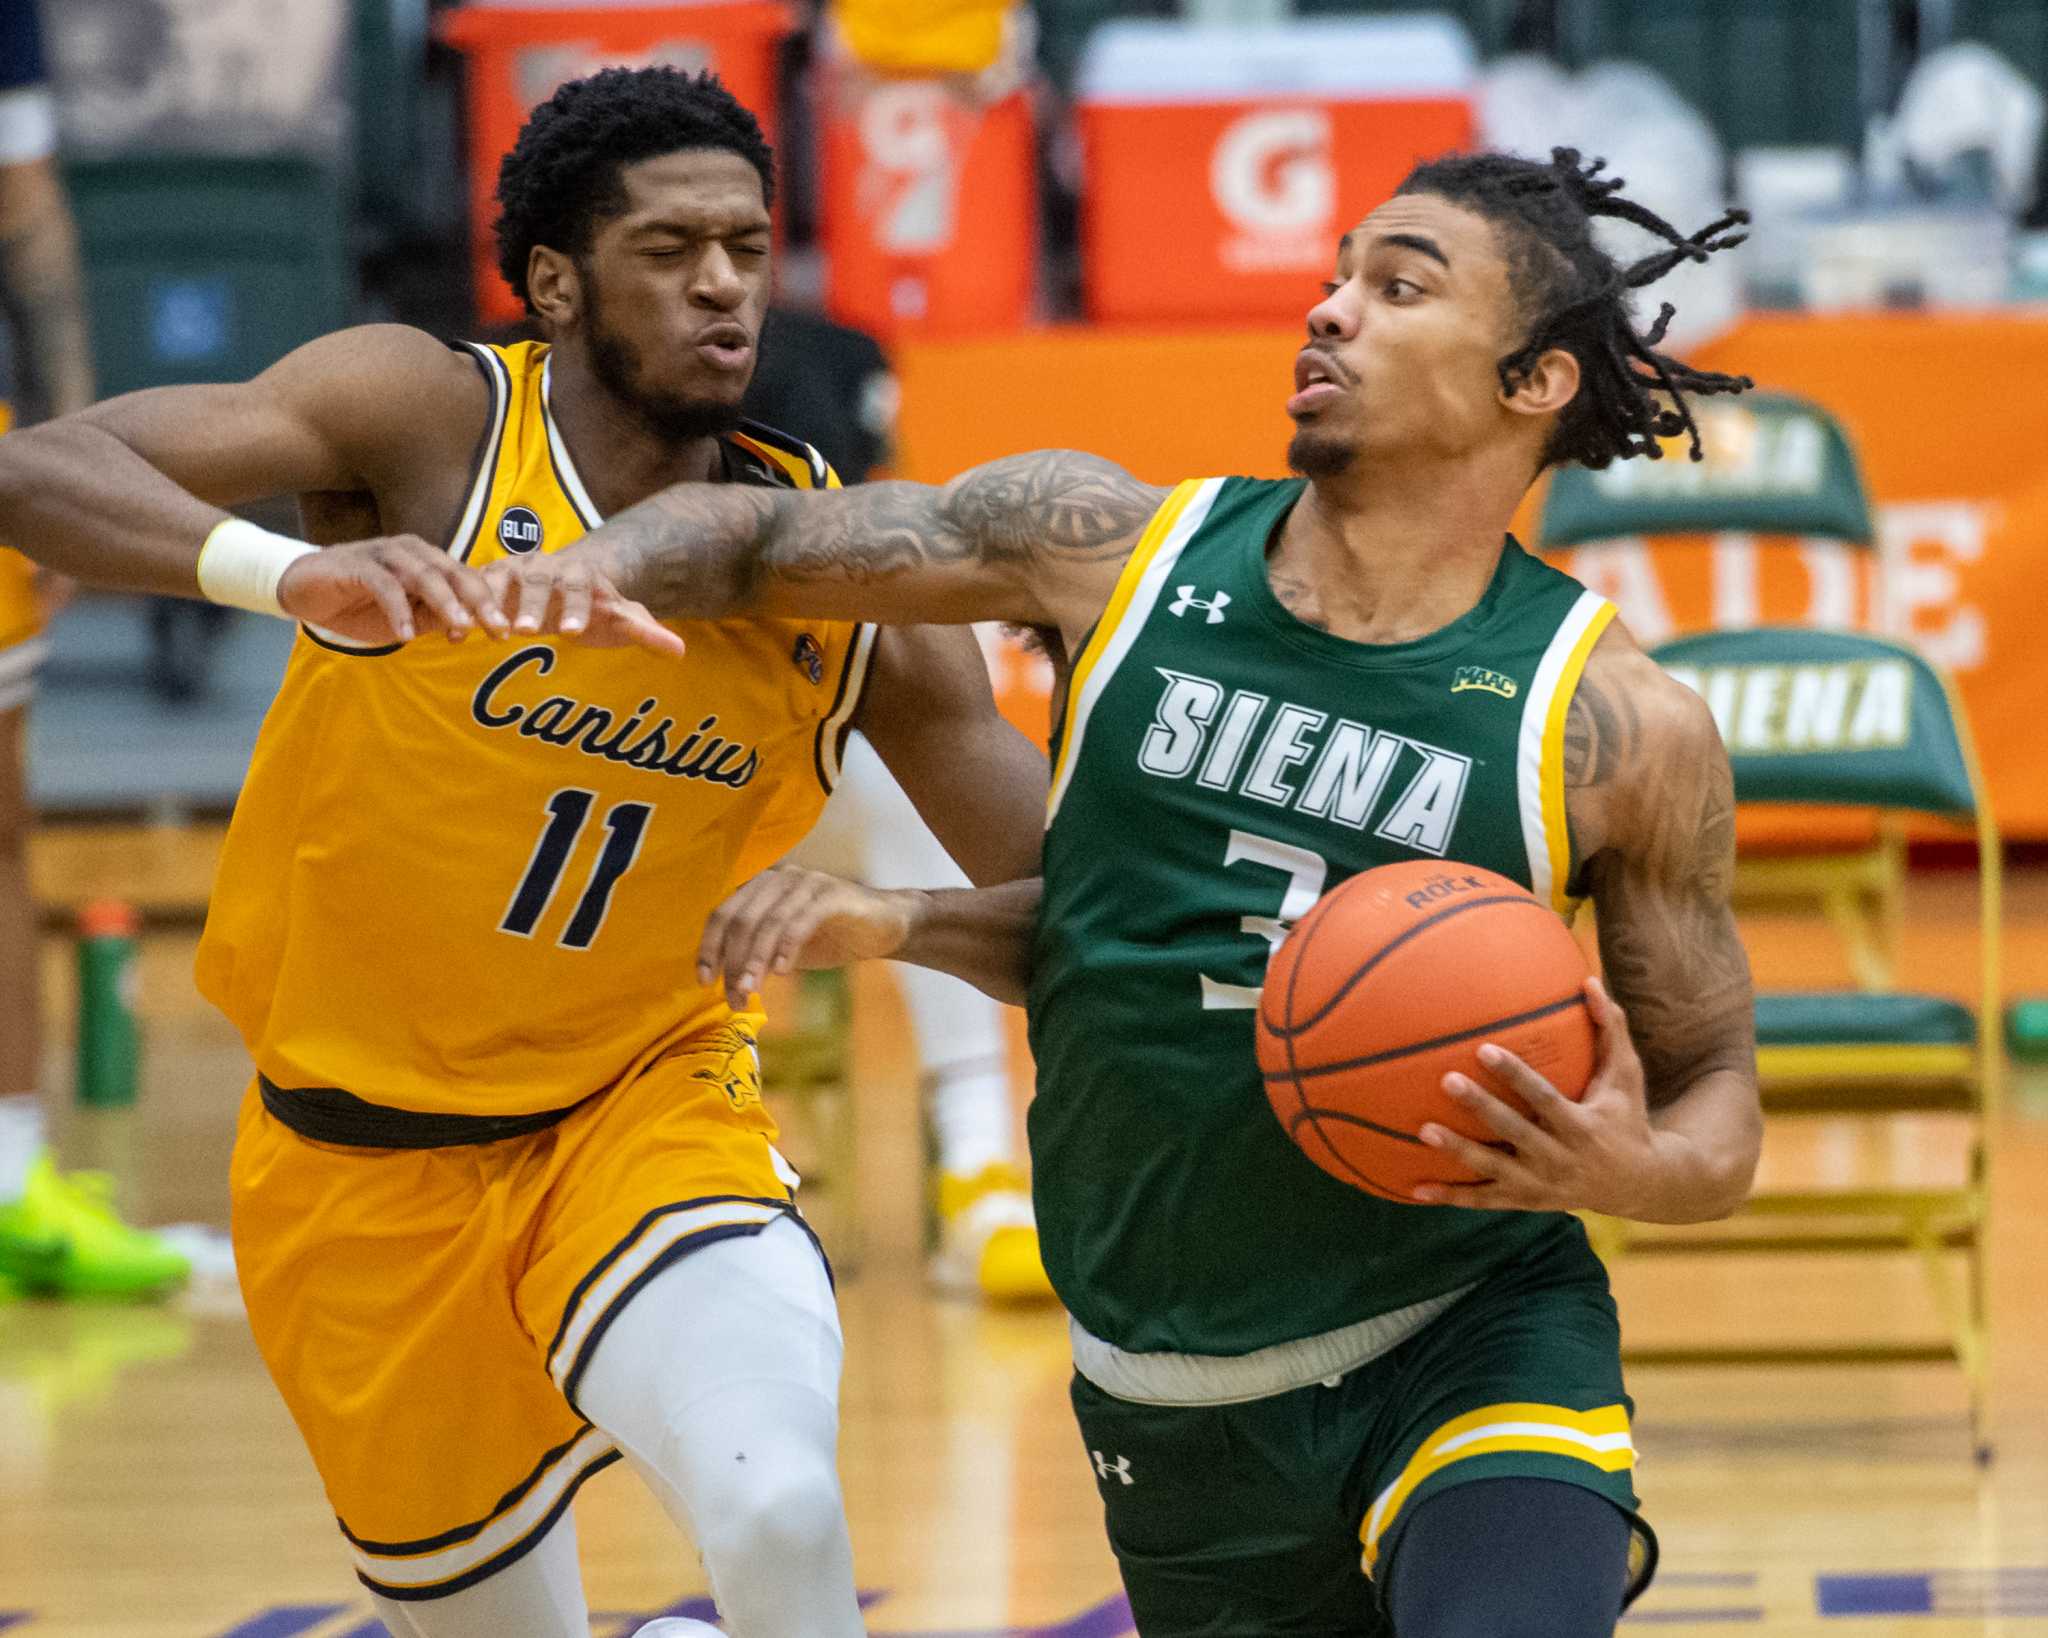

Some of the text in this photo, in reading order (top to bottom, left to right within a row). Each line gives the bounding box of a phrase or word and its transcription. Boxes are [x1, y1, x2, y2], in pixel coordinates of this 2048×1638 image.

[1210, 112, 1337, 228] G
[502, 519, 538, 542] BLM
[471, 645, 763, 789] Canisius
[1451, 665, 1518, 699] MAAC
[1137, 666, 1473, 857] SIENA
[496, 786, 656, 951] 11
[1406, 875, 1488, 909] ROCK
